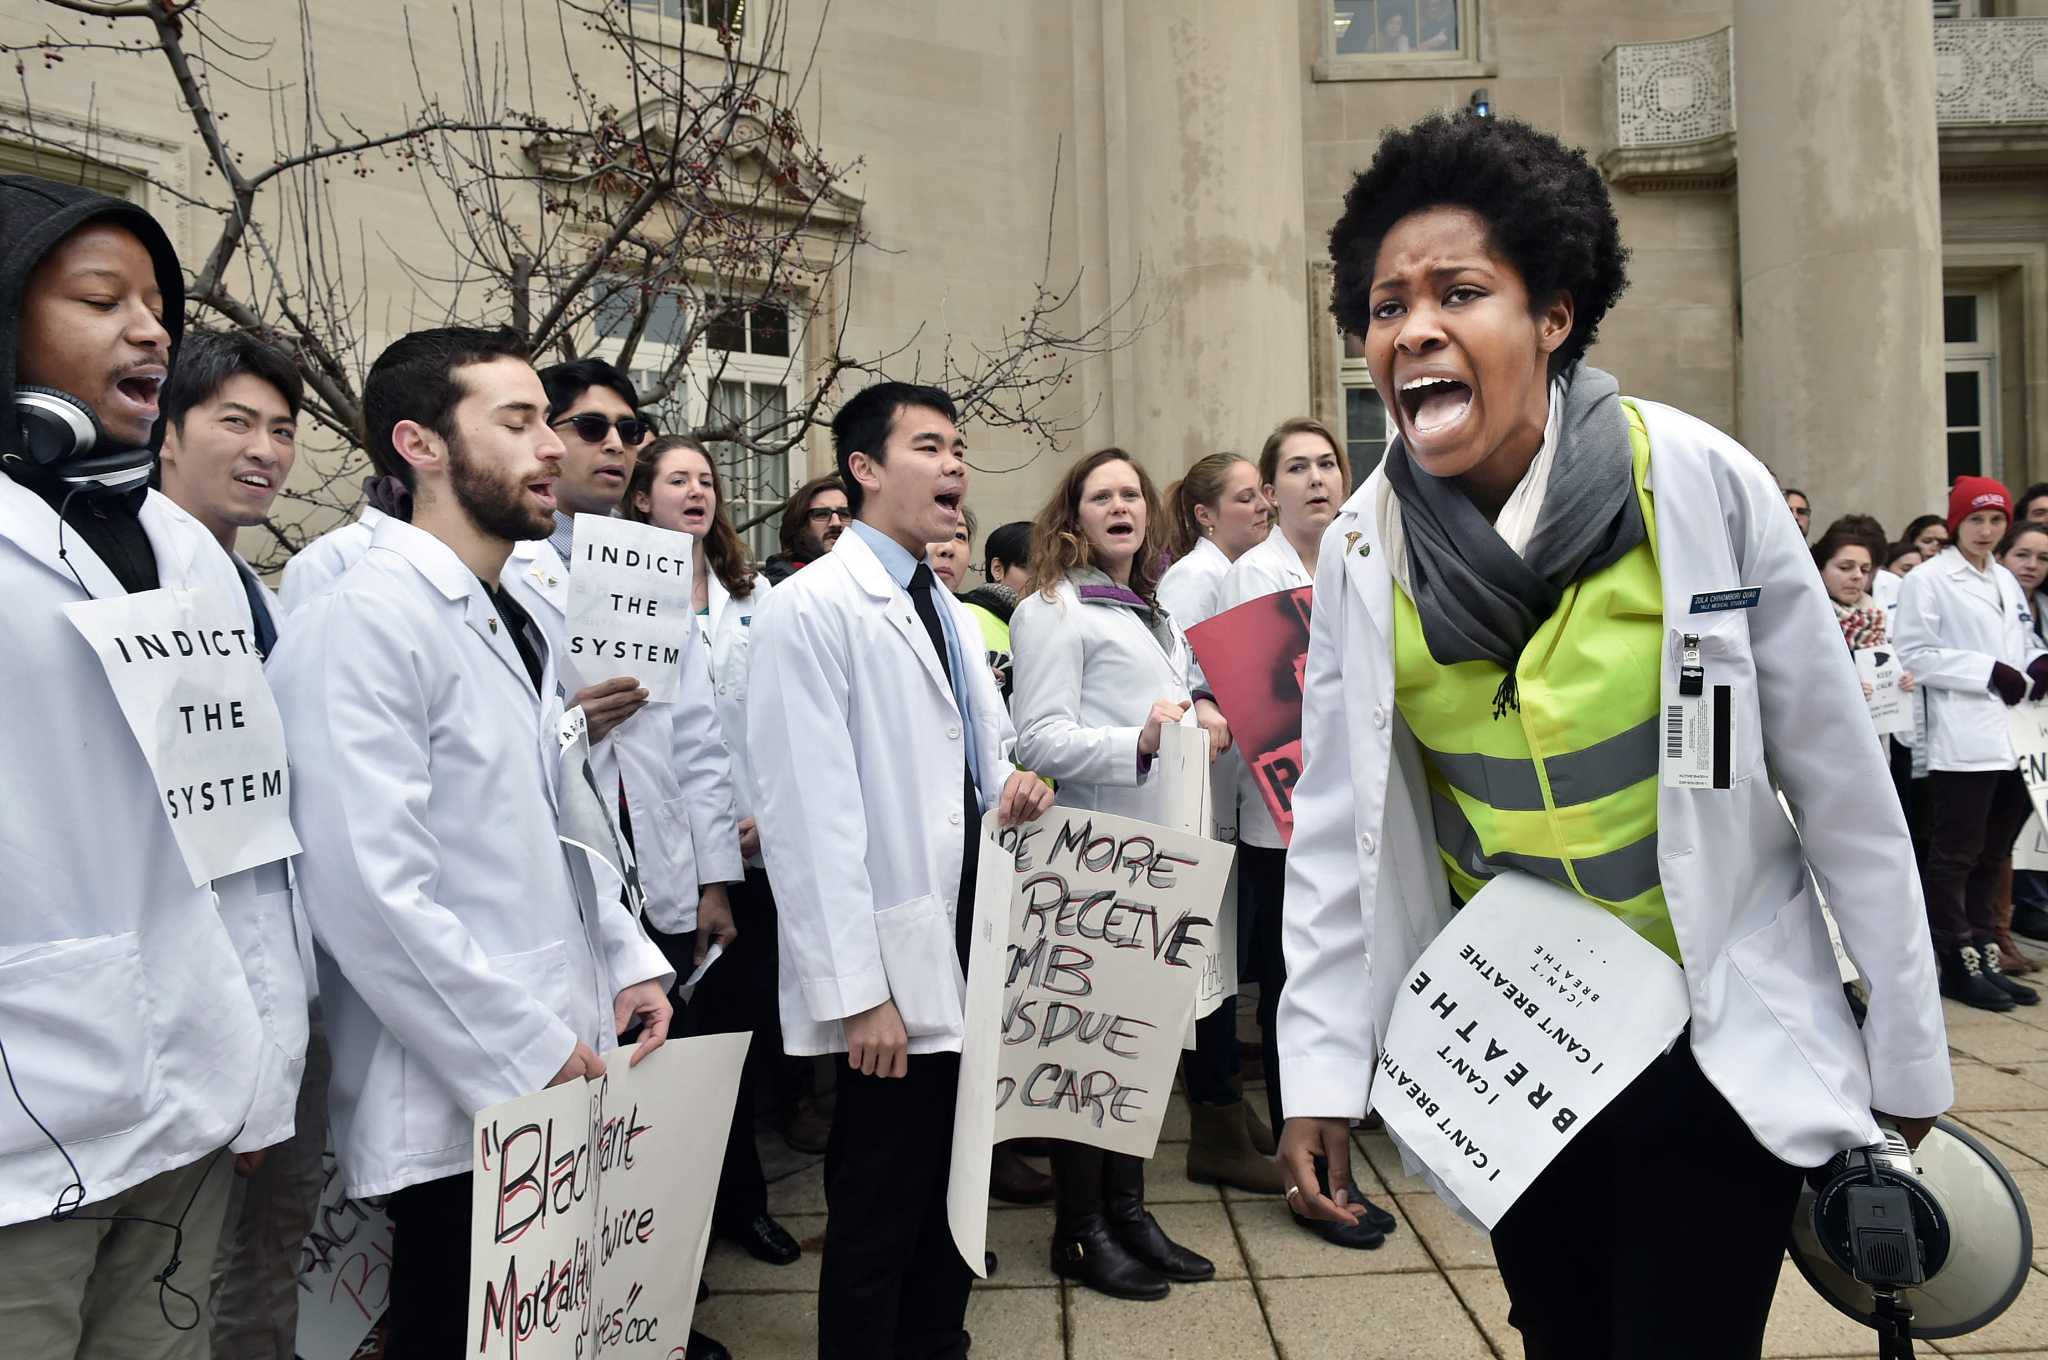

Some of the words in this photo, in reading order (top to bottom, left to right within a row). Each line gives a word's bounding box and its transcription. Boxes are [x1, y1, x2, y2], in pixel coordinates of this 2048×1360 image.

[588, 544, 684, 576] INDICT
[610, 594, 658, 617] THE
[115, 629, 248, 663] INDICT
[571, 636, 680, 665] SYSTEM
[179, 701, 245, 734] THE
[167, 769, 281, 819] SYSTEM
[1046, 818, 1200, 888] MORE
[1022, 871, 1213, 968] RECEIVE
[1459, 944, 1540, 1019] BREATHE
[1530, 963, 1576, 1003] CAN'T
[1531, 945, 1600, 1002] BREATHE
[1575, 1000, 1583, 1008] I
[1409, 970, 1578, 1134] BREATHE
[1536, 1017, 1591, 1063] CAN'T
[1436, 1045, 1489, 1094] CAN'T
[1591, 1062, 1604, 1075] I
[1019, 1062, 1149, 1128] CARE
[1487, 1093, 1500, 1105] I
[1436, 1117, 1488, 1169] CAN'T
[1488, 1168, 1501, 1182] I
[601, 1205, 656, 1267] twice
